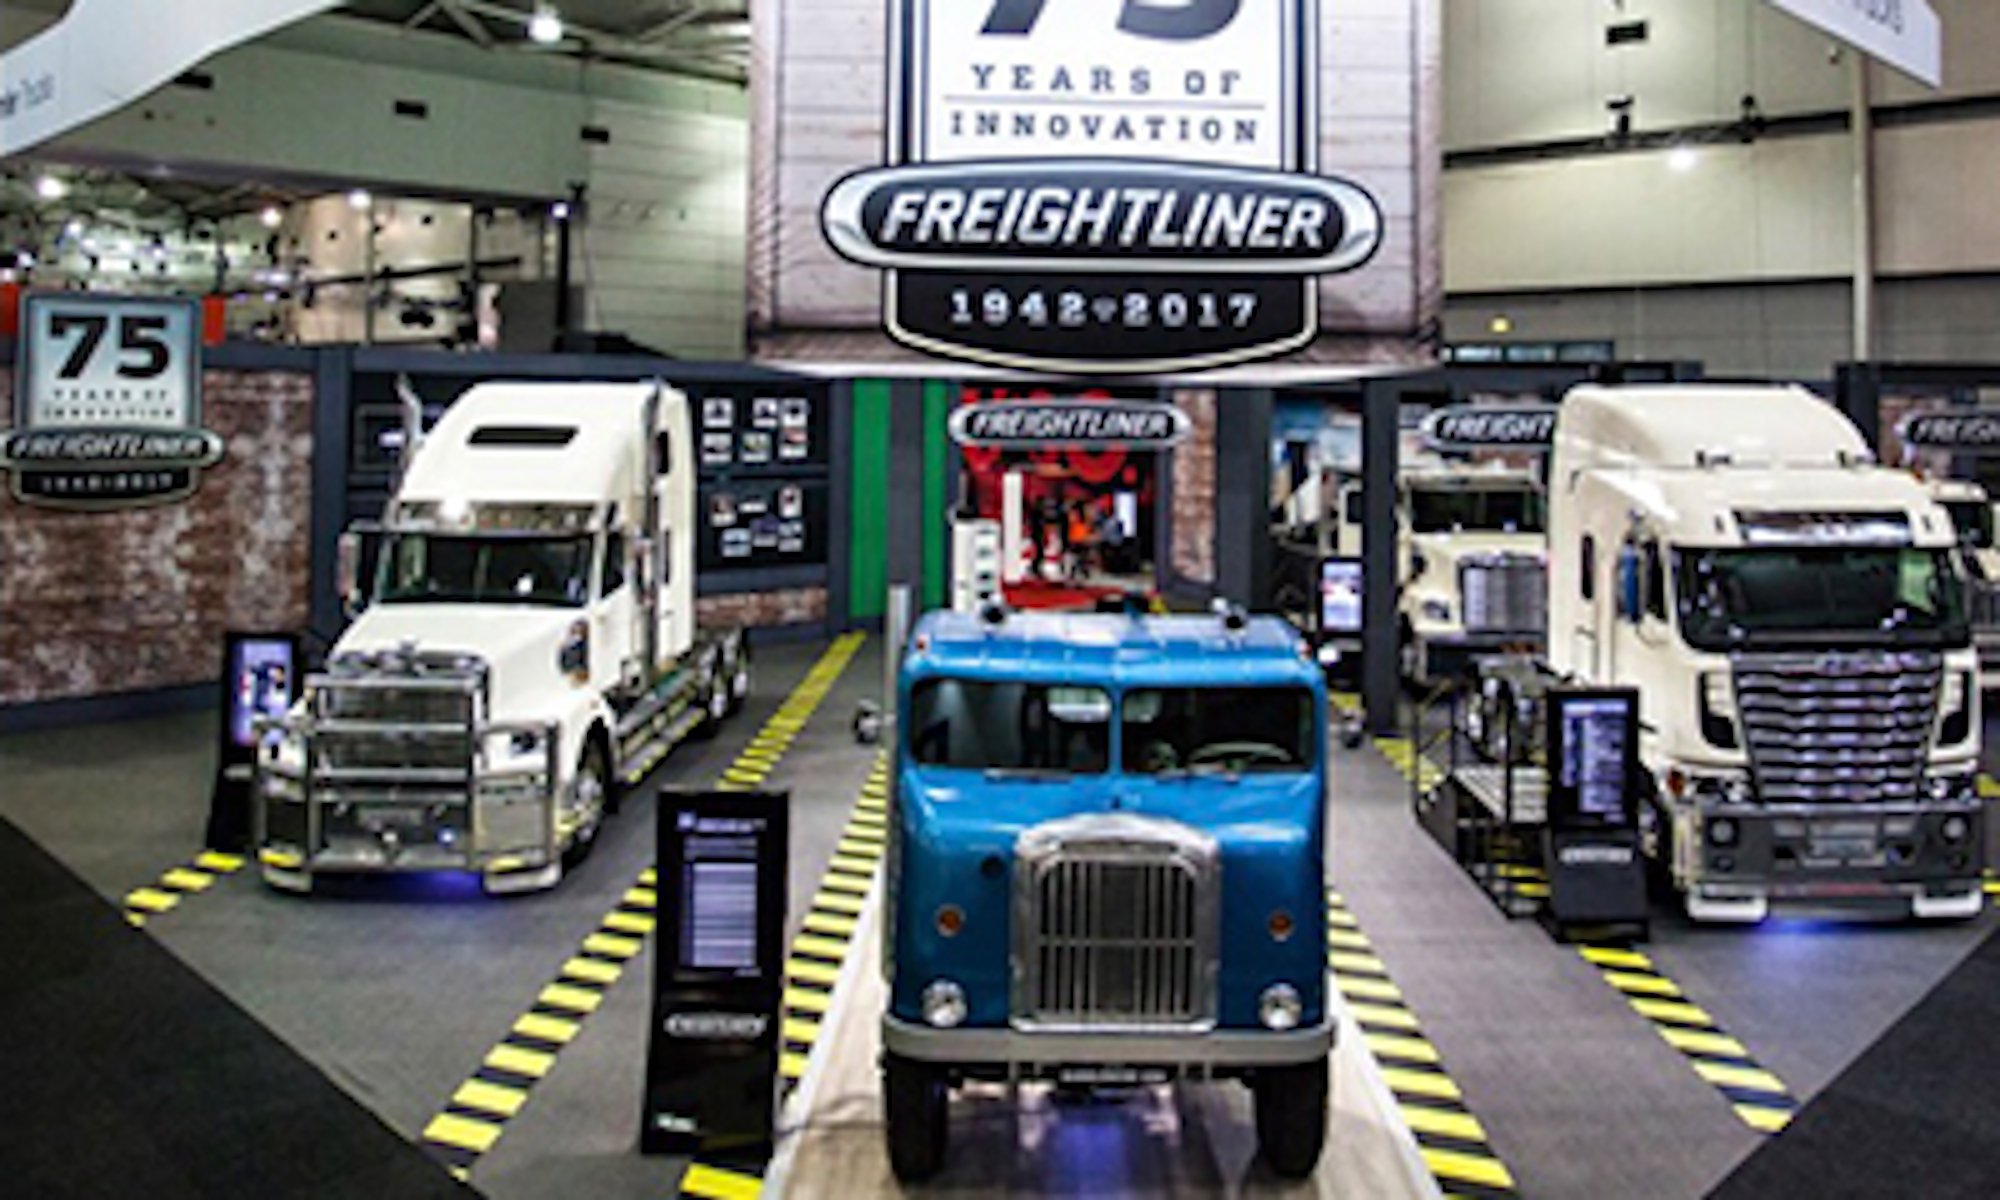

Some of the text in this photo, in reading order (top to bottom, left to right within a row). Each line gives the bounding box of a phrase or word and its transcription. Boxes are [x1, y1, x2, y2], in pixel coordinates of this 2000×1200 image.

[972, 64, 1241, 96] YEARS OF
[949, 111, 1258, 142] INNOVATION
[879, 187, 1328, 248] FREIGHTLINER
[949, 290, 1258, 327] 1942 2017
[49, 315, 169, 379] 75
[972, 406, 1169, 438] FREIGHTLINER
